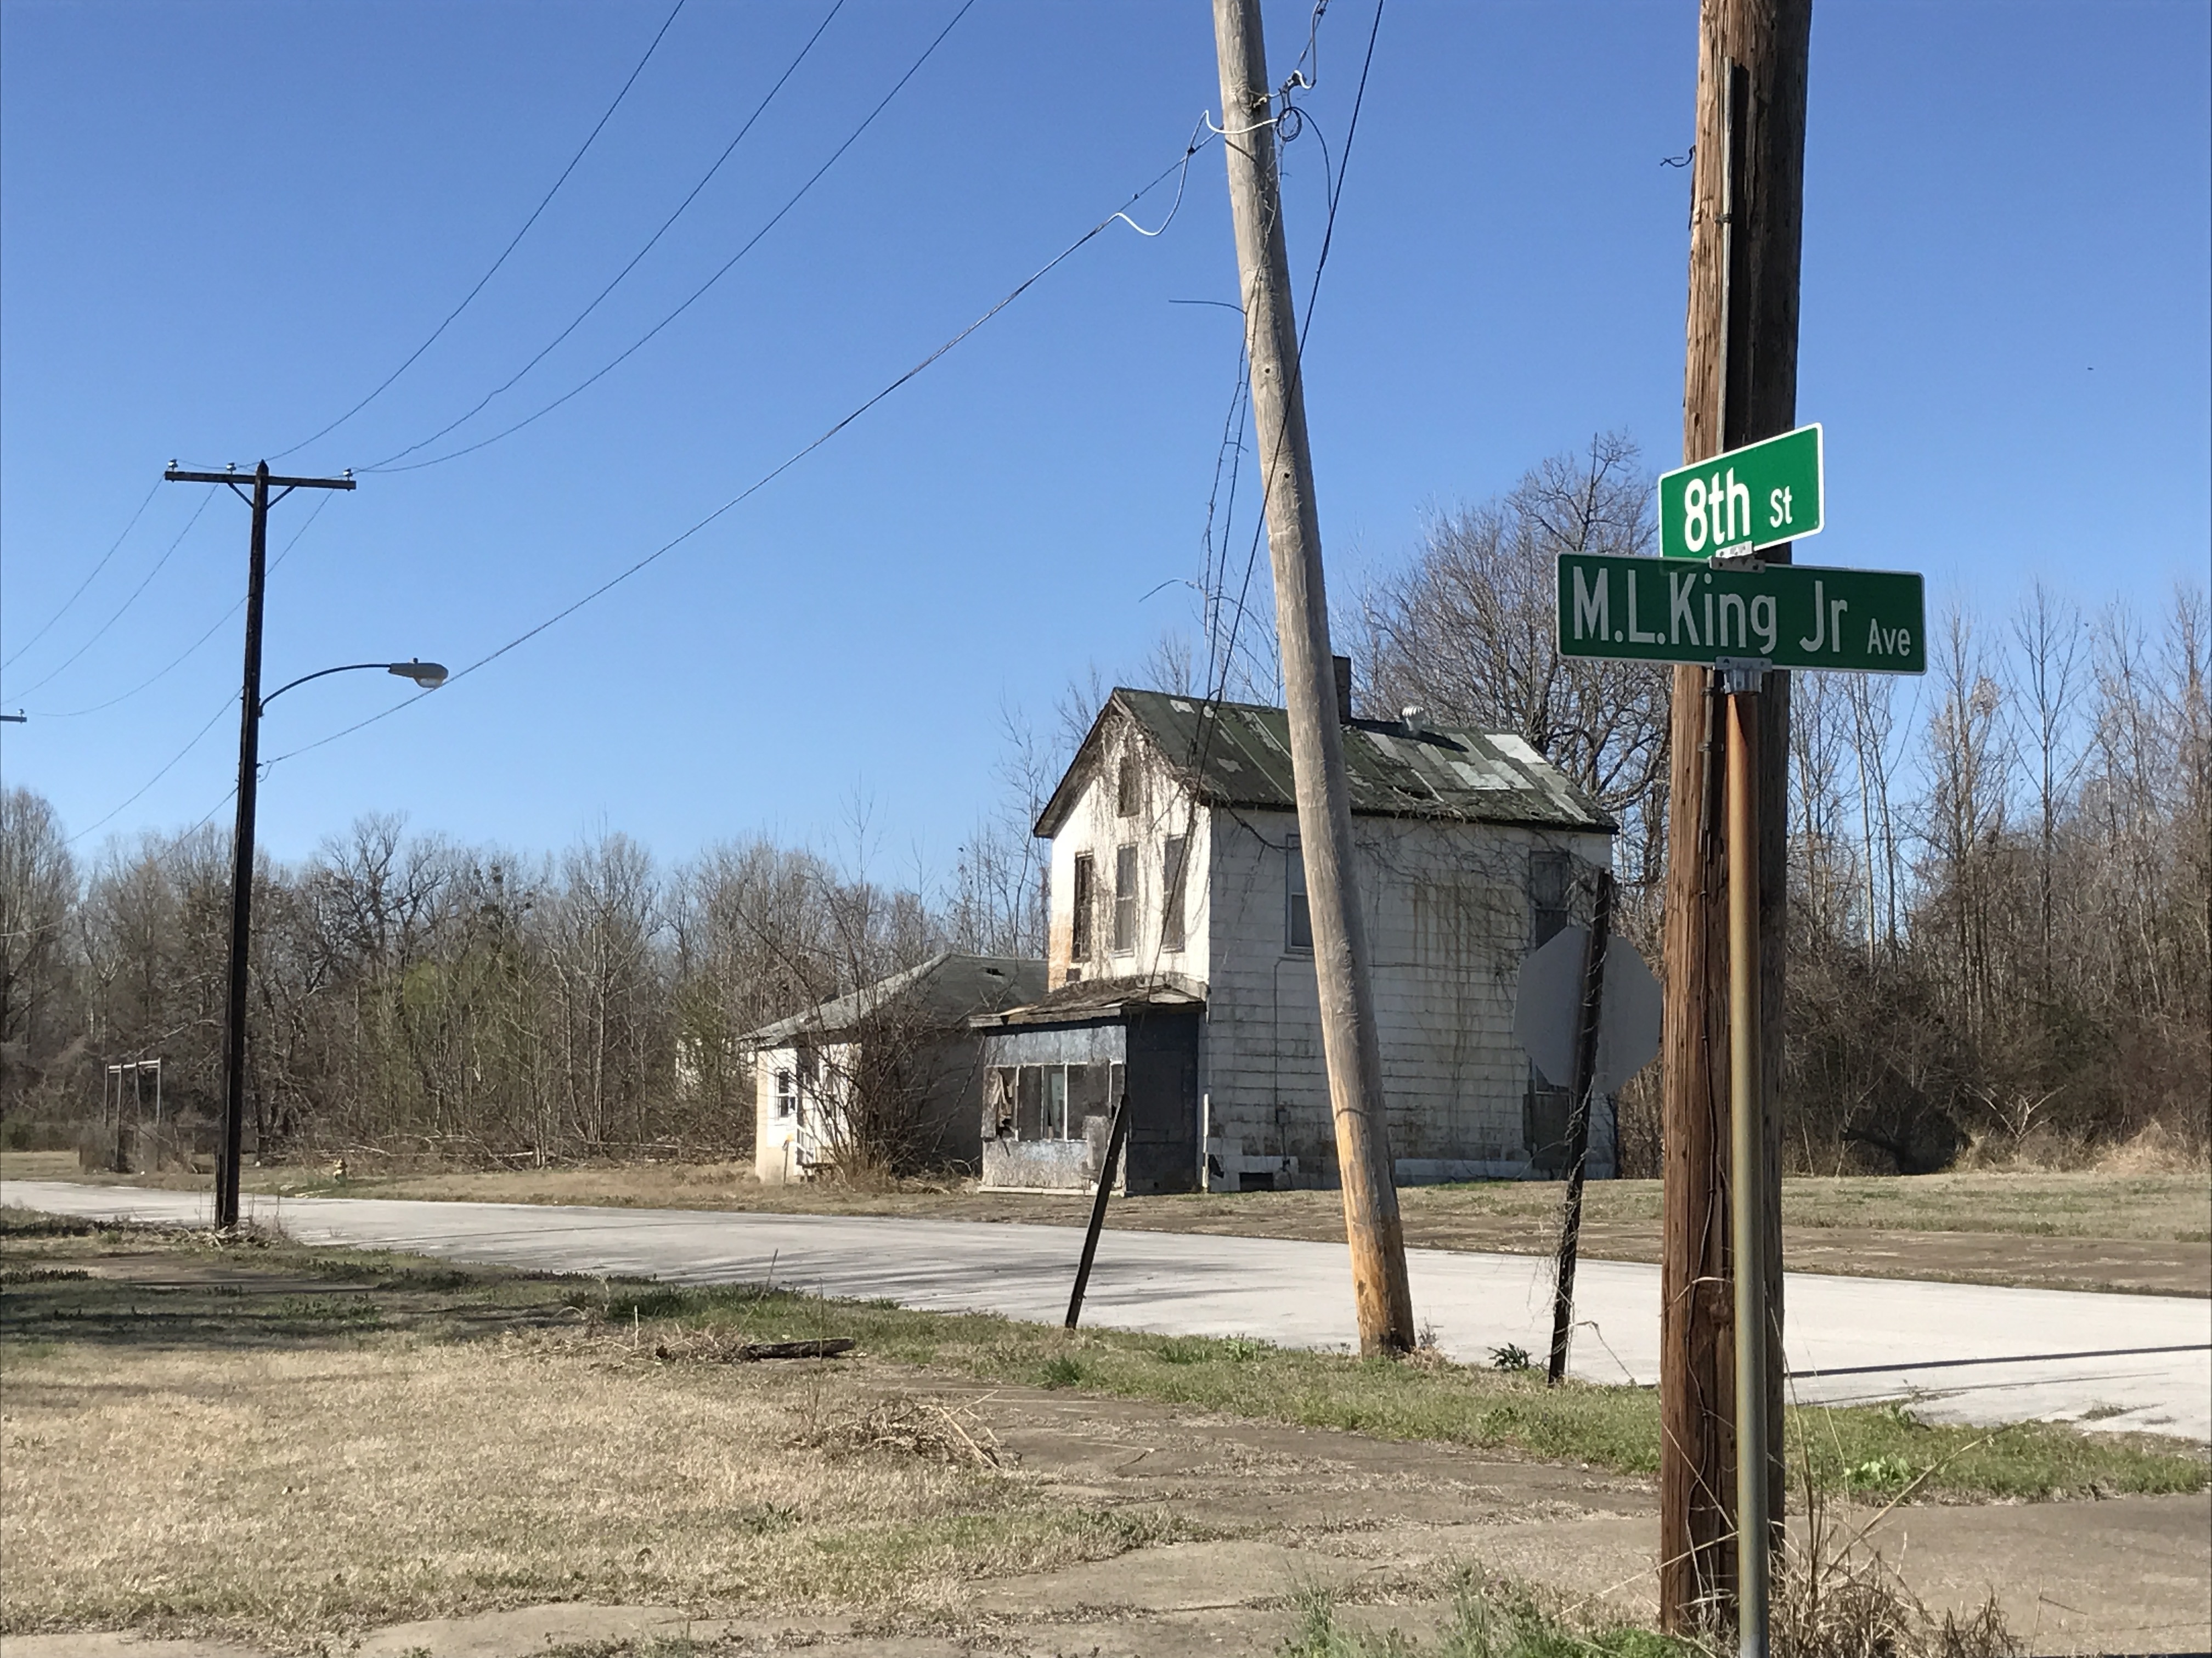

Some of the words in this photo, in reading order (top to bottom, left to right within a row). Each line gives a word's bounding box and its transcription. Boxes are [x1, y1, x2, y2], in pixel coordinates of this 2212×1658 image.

[1684, 468, 1750, 552] 8th
[1770, 486, 1793, 528] St
[1799, 580, 1847, 653] Jr
[1867, 618, 1911, 656] Ave
